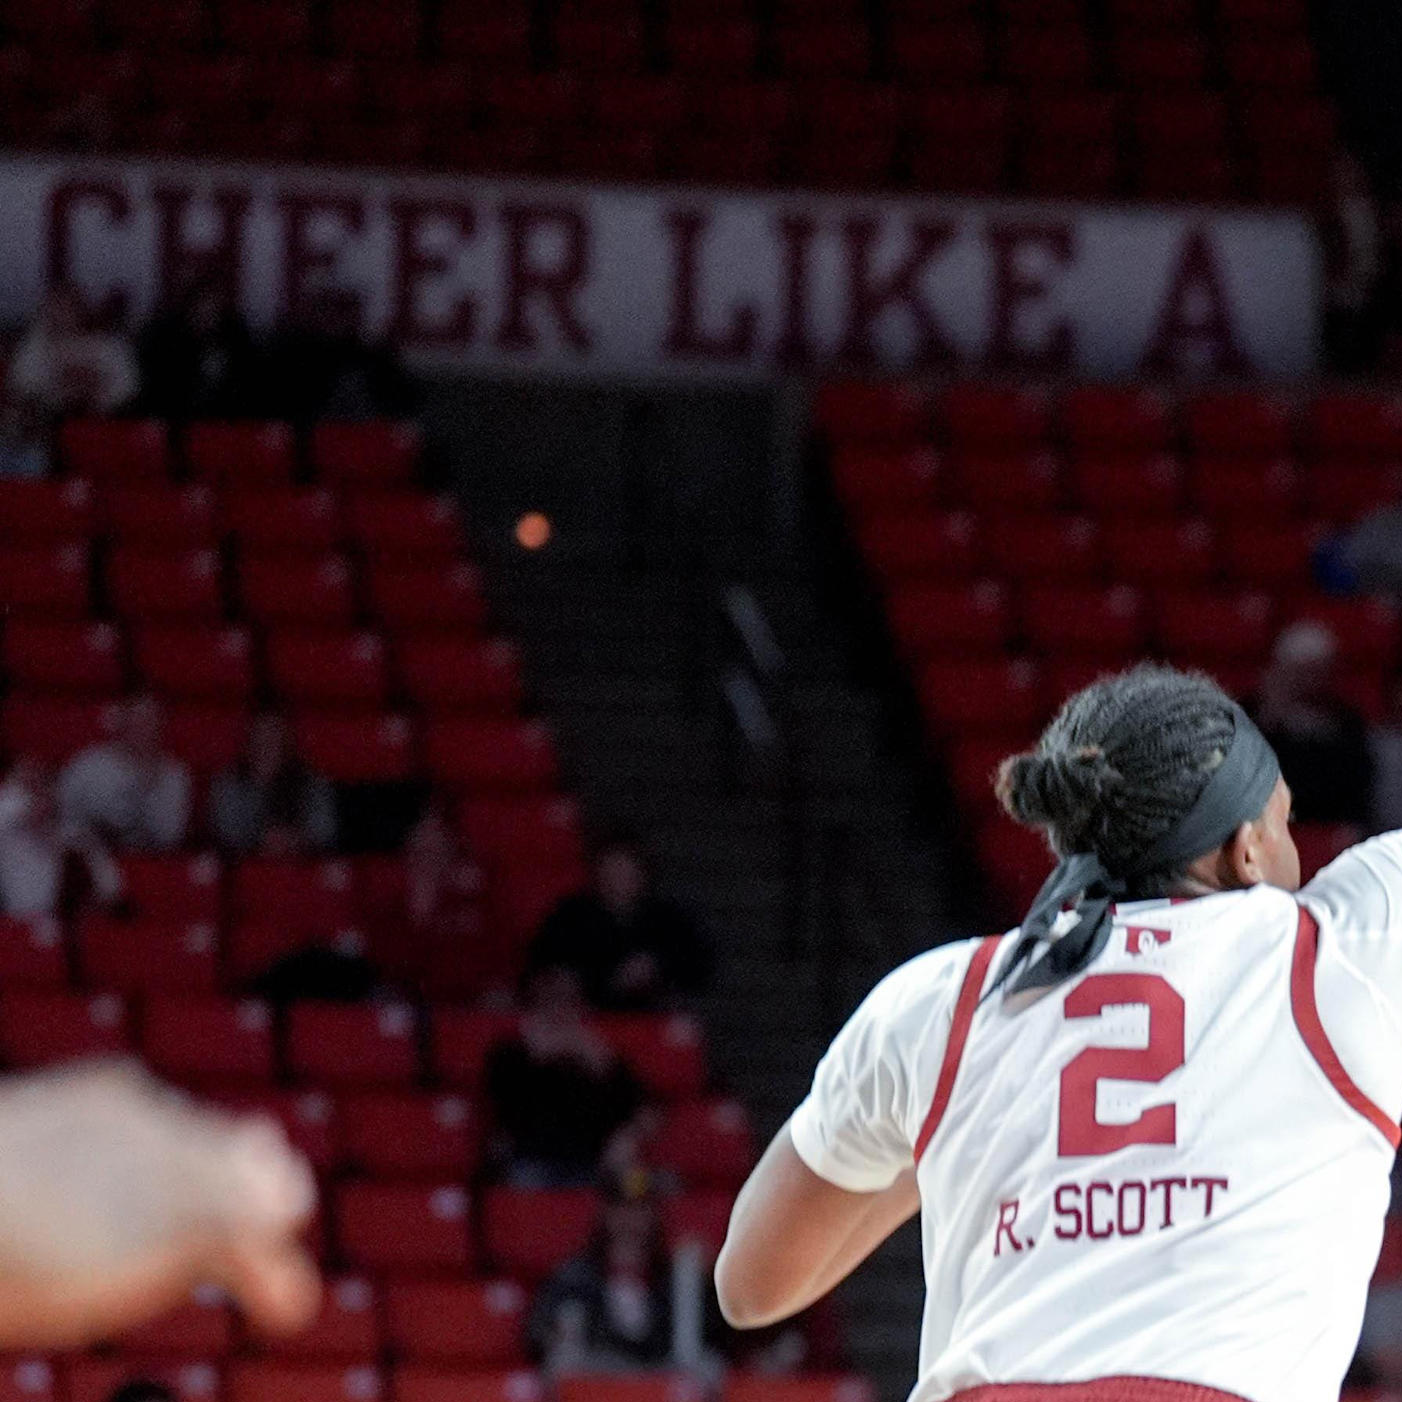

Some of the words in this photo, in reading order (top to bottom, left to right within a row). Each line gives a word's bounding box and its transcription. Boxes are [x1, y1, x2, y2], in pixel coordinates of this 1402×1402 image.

[42, 178, 594, 354] CHEER
[660, 207, 1080, 374] LIKE
[1136, 222, 1256, 378] A
[1058, 972, 1185, 1158] 2
[993, 1199, 1035, 1257] R.
[1054, 1177, 1229, 1242] SCOTT
